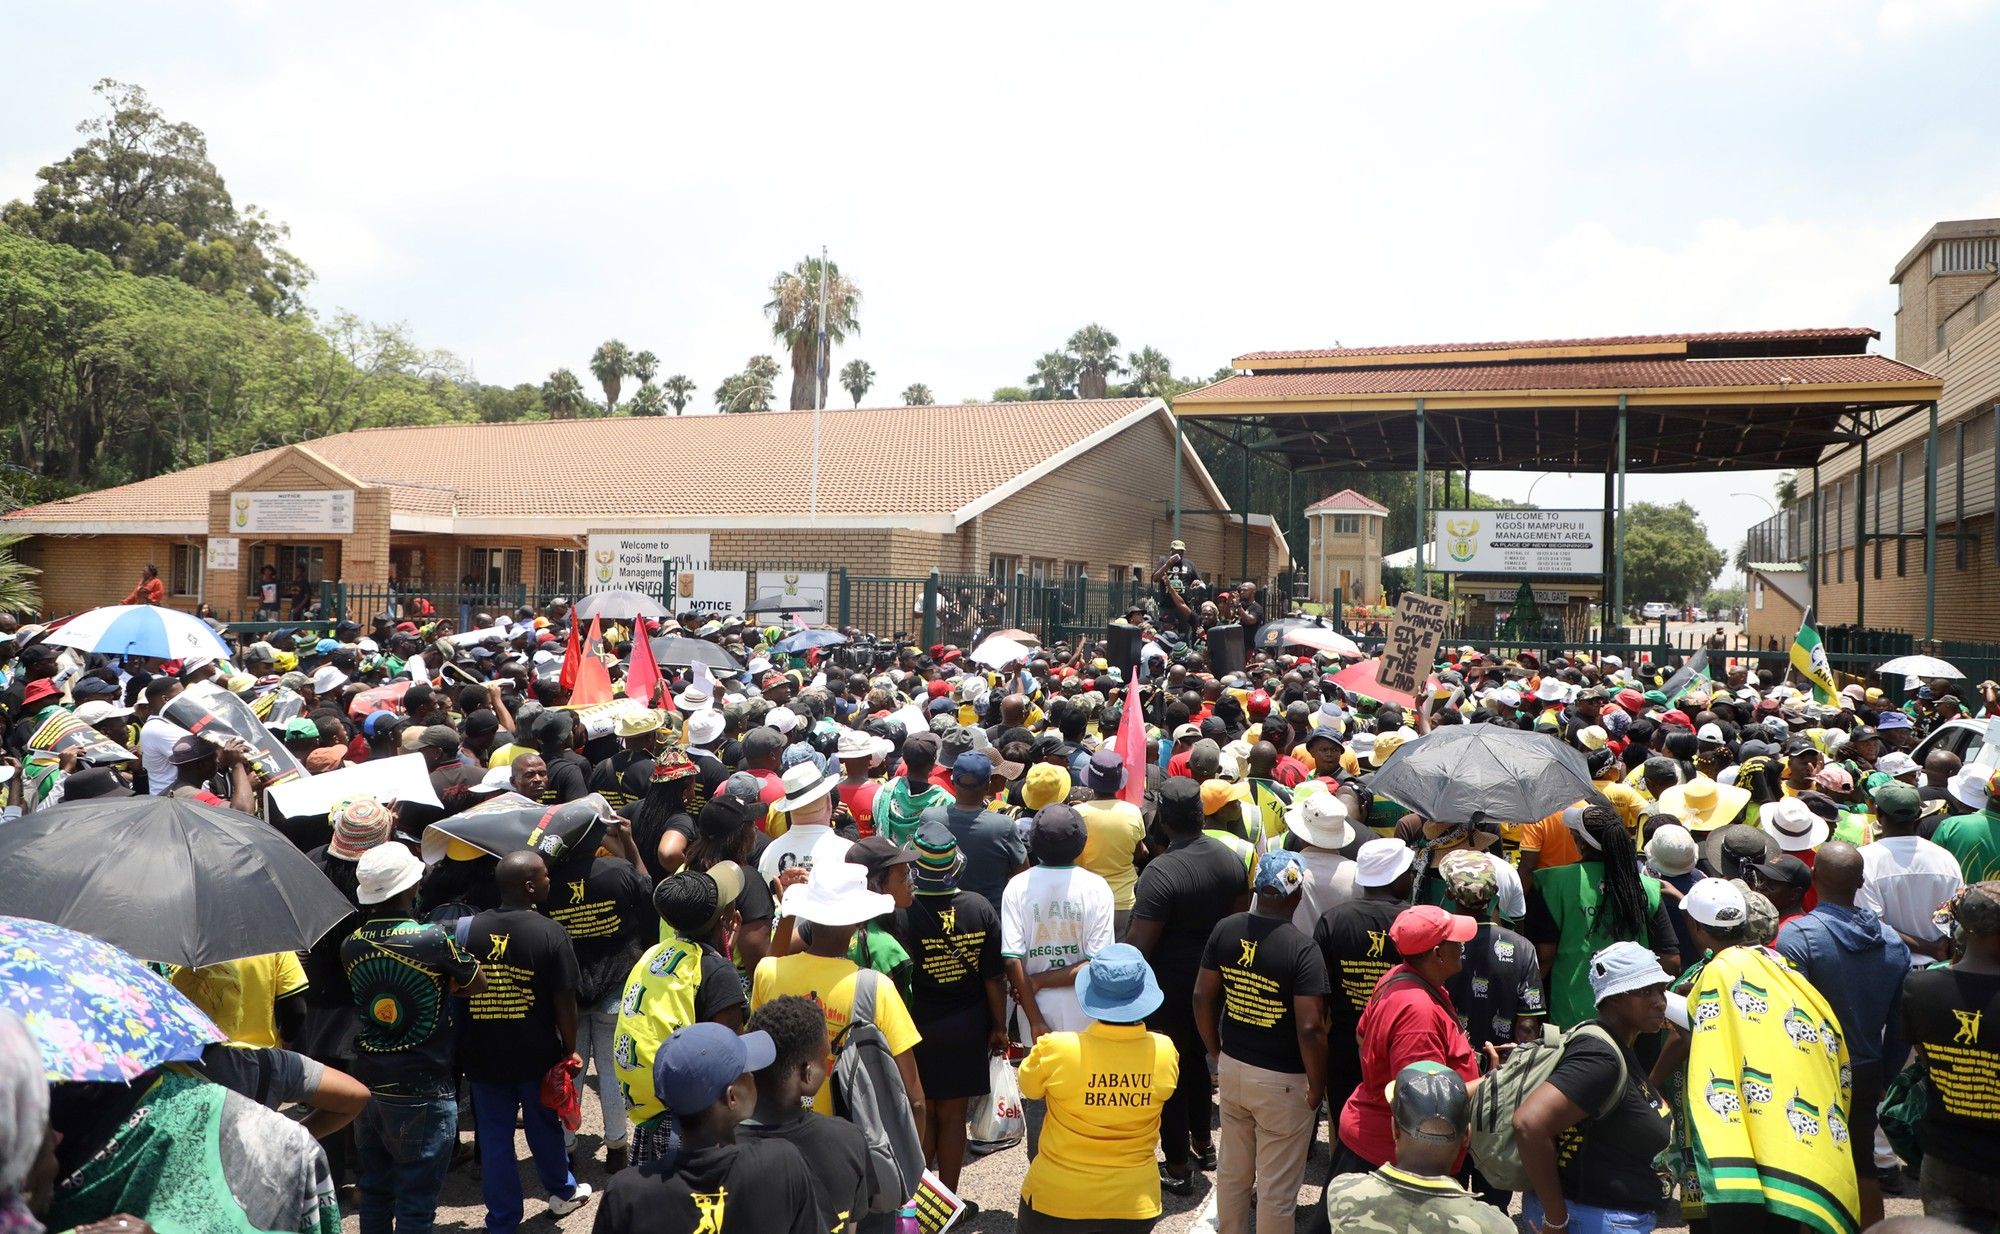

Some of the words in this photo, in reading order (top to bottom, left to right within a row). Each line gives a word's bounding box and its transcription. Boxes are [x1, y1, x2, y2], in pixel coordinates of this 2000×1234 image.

[621, 541, 658, 550] Welcome
[660, 541, 669, 550] to
[620, 553, 643, 566] Kgoši
[645, 554, 684, 563] Mamuru
[620, 568, 662, 579] Manageme
[628, 582, 676, 591] VISITOS
[1499, 591, 1518, 600] ACCES
[1552, 592, 1566, 601] GATE
[690, 600, 732, 610] NOTICE
[1404, 596, 1443, 616] TAKE
[1394, 626, 1433, 648] GIVE
[1386, 654, 1417, 675] THE
[1381, 669, 1415, 691] LAND
[1814, 669, 1832, 686] ANC
[1267, 800, 1285, 818] AN
[381, 927, 420, 937] LEAGUE
[1030, 944, 1079, 958] REGISTE
[1049, 959, 1065, 967] TO
[1748, 1016, 1761, 1024] ANC
[1798, 1046, 1810, 1054] ANC
[1088, 1073, 1152, 1088] JABAVU
[1084, 1092, 1152, 1107] BRANCH
[1802, 1138, 1813, 1147] ANC
